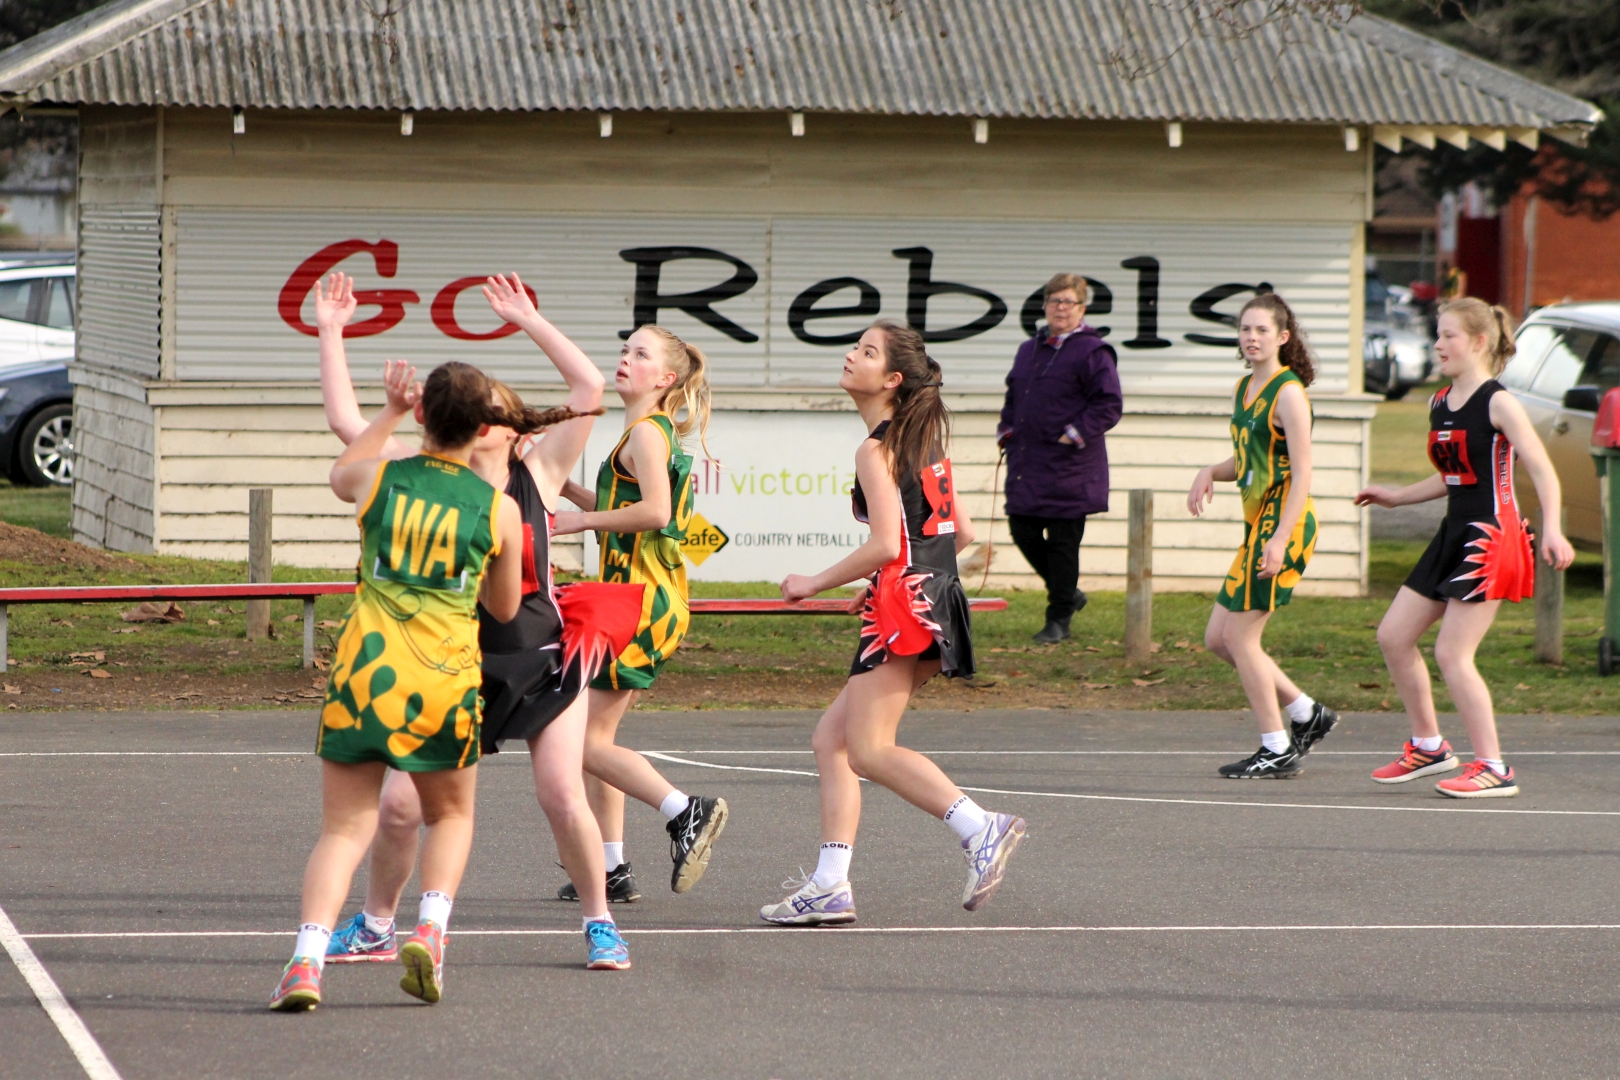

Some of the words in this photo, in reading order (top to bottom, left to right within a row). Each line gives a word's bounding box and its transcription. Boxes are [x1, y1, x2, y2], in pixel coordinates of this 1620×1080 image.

[277, 239, 539, 341] Go
[618, 246, 1275, 350] Rebels
[1431, 441, 1469, 473] GK
[390, 494, 460, 580] WA
[735, 533, 793, 547] COUNTRY
[797, 533, 854, 547] NETBALL
